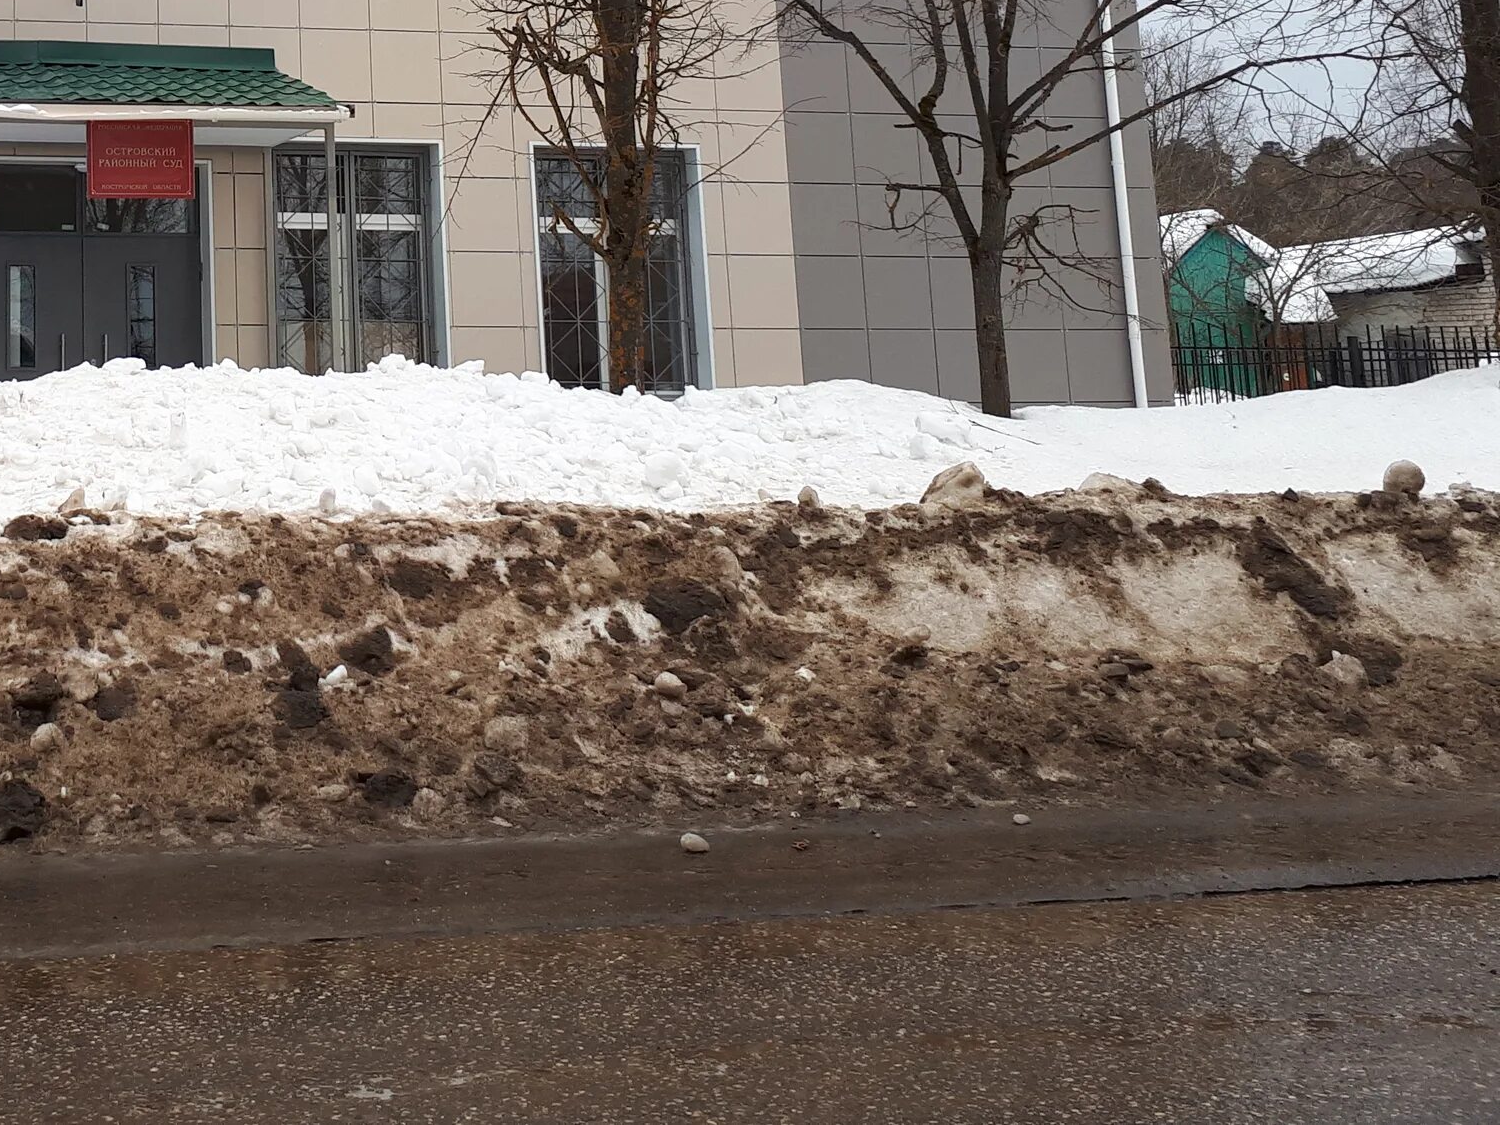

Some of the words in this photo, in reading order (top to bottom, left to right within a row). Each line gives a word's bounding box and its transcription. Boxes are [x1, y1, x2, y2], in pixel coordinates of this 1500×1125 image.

[105, 146, 176, 156] ОСТРОВСКИЙ
[98, 158, 156, 168] РАЙОННЫЙ
[162, 159, 183, 169] СУД
